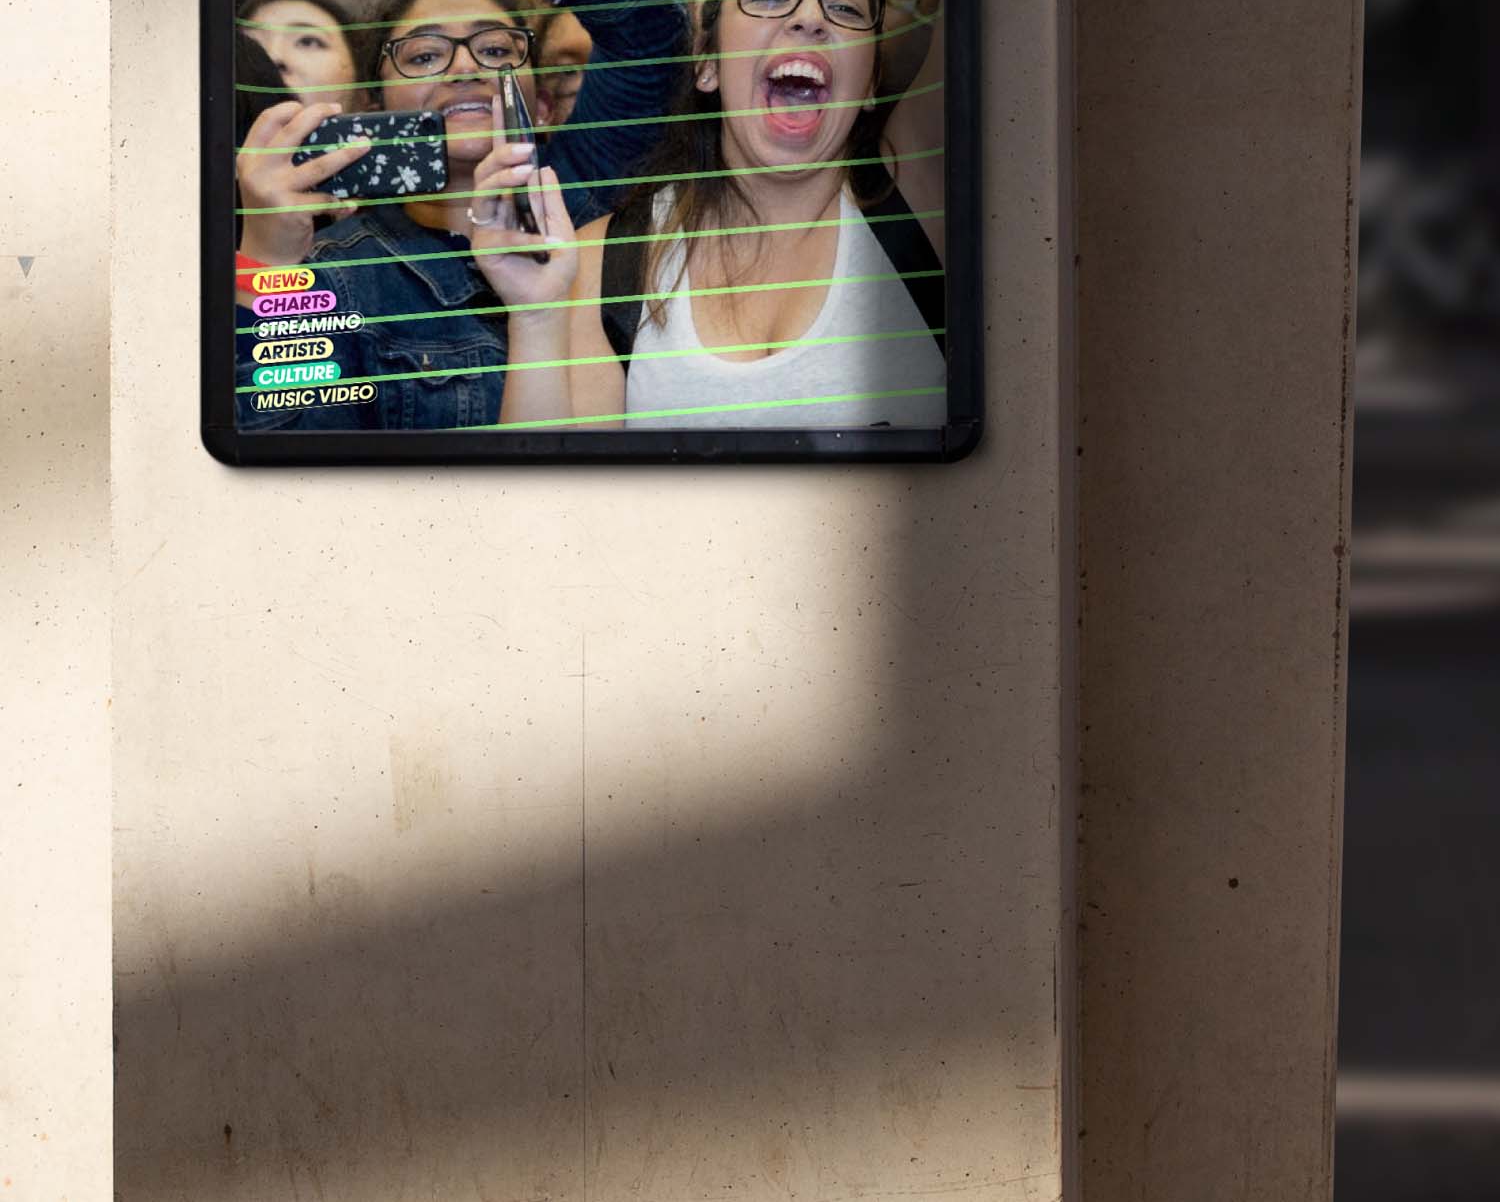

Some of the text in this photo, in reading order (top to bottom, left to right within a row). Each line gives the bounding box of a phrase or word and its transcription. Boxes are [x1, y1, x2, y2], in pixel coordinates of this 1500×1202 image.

[258, 272, 309, 289] NEWS
[259, 294, 330, 313] CHARTS
[259, 314, 361, 337] STREAMING
[259, 341, 326, 360] ARTISTS
[259, 365, 335, 385] CULTURE
[257, 385, 373, 409] MUSIC VIDEO
